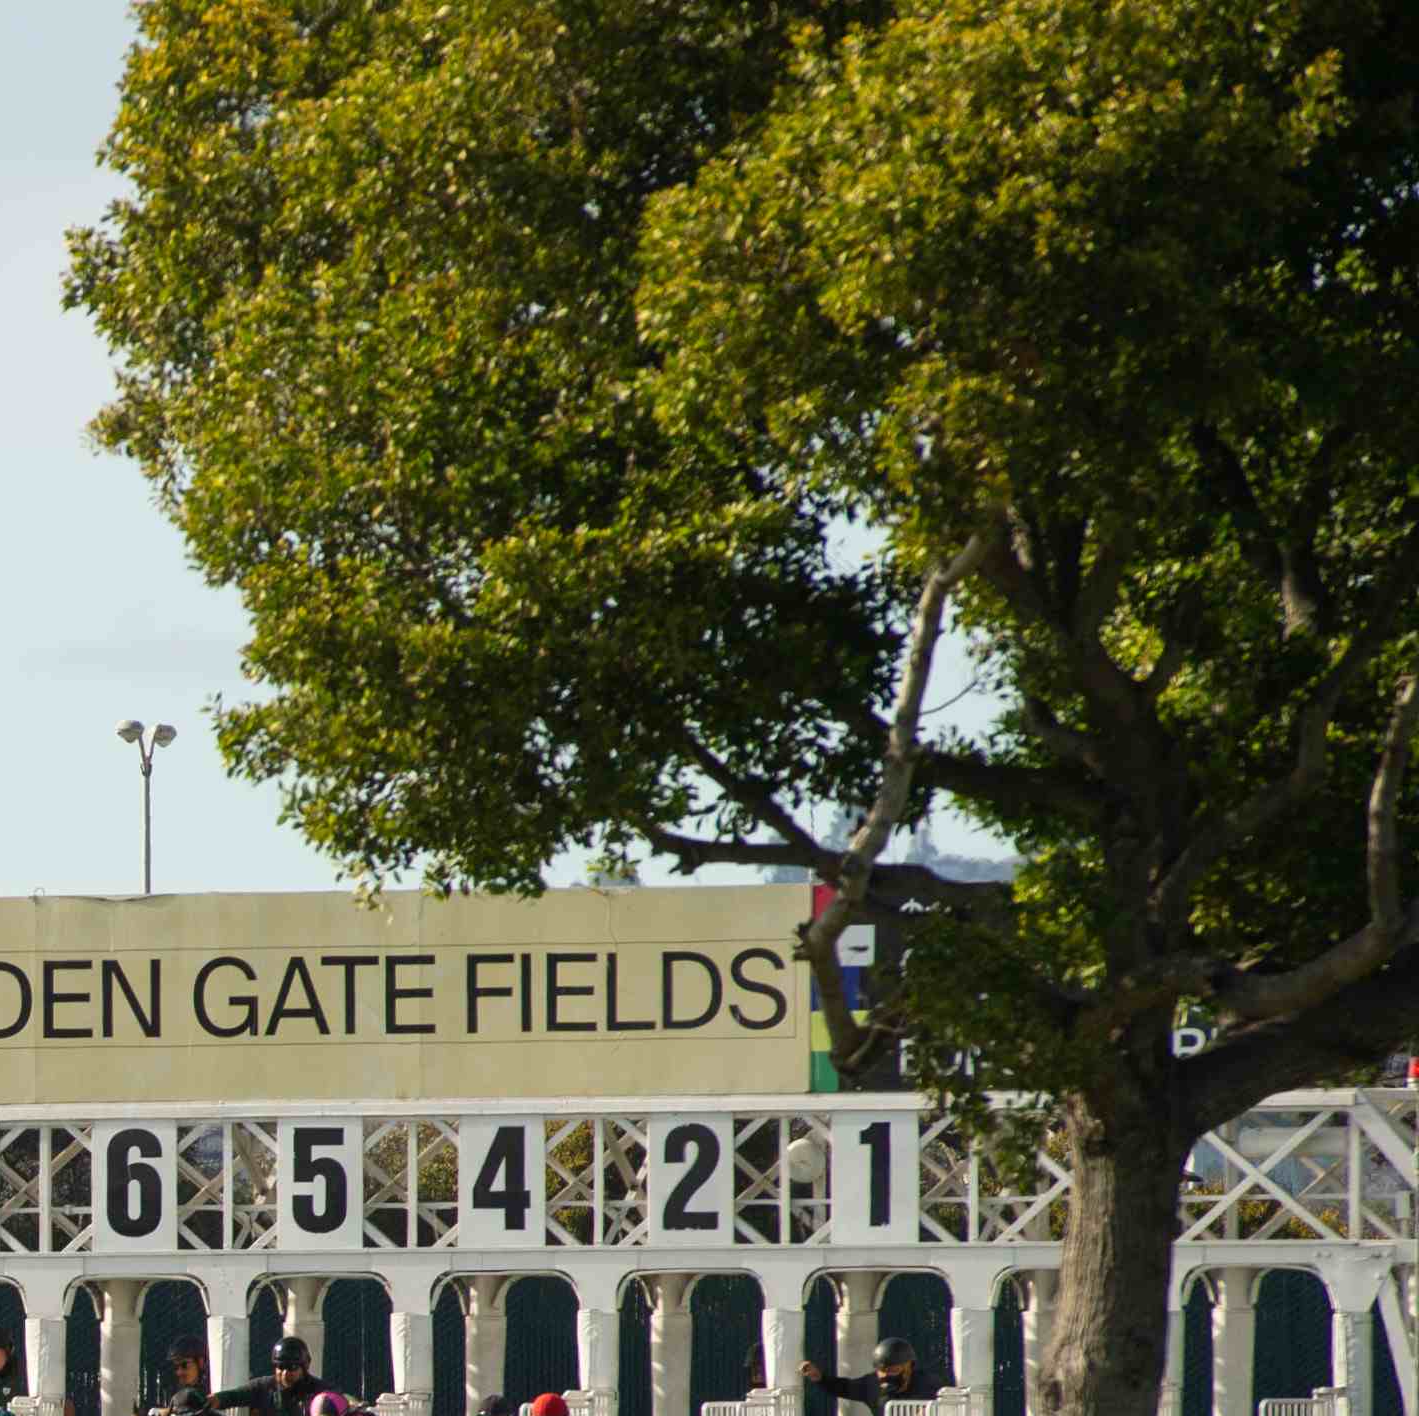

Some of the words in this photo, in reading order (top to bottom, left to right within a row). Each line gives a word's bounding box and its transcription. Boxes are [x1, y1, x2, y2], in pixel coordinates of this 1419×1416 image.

[192, 954, 437, 1038] GATE
[465, 947, 788, 1035] FIELDS
[106, 1128, 164, 1238] 6
[292, 1126, 349, 1235] 5
[471, 1126, 532, 1231] 4
[661, 1123, 721, 1231] 2
[858, 1121, 892, 1228] 1
